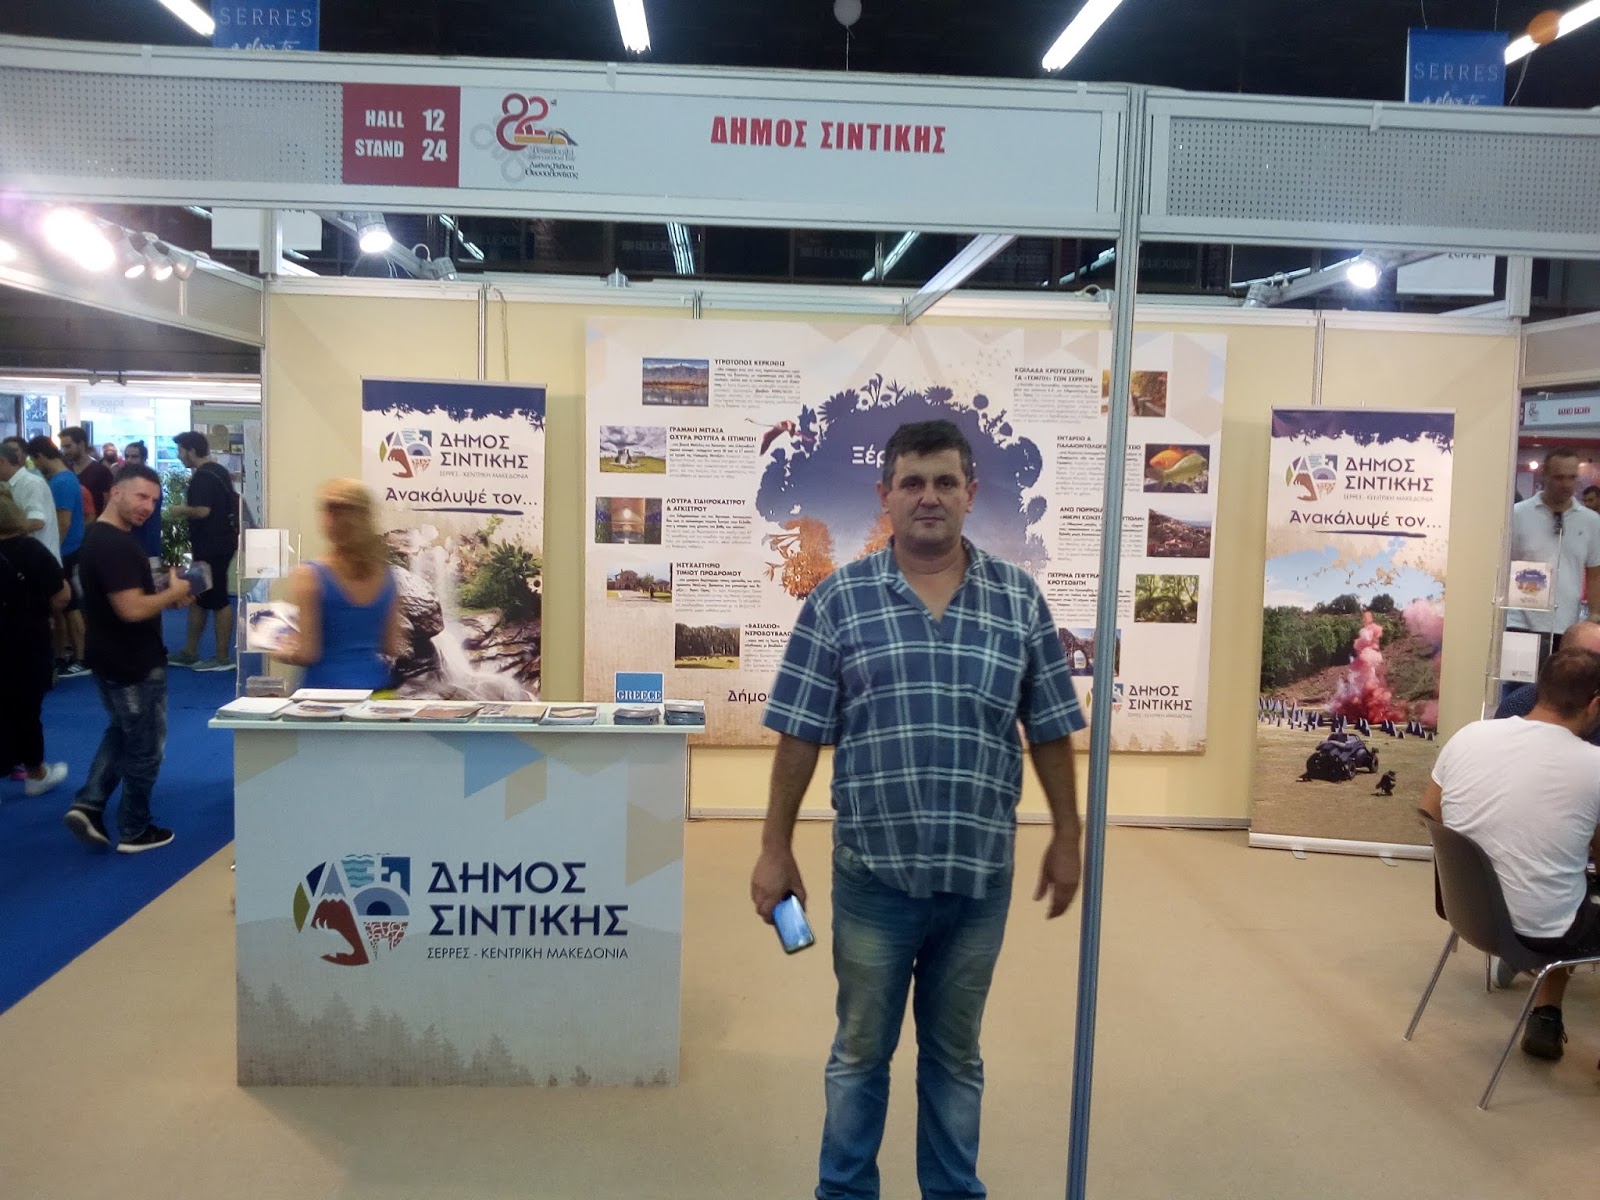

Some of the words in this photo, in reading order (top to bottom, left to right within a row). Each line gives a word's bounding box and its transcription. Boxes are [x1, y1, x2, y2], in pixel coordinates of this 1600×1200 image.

[219, 7, 313, 26] SERRES
[1414, 62, 1498, 81] SERRES
[365, 109, 405, 129] HALL
[422, 108, 446, 133] 12
[710, 115, 808, 149] ΔΗΜΟΣ
[820, 120, 947, 154] ΣΙΝΤΙΚΗΣ
[354, 138, 405, 159] STAND
[421, 138, 448, 163] 24
[440, 432, 510, 450] ΔΗΜΟΣ
[440, 451, 529, 469] ΣΙΝΤΙΚΗΣ
[851, 443, 886, 468] Ξέρ
[1345, 456, 1415, 472] ΔΗΜΟΣ
[1345, 475, 1434, 491] ΣΙΝΤΙΚΗΣ
[616, 690, 663, 701] GREECE
[1128, 684, 1180, 697] ΔΗΜΟΣ
[1128, 699, 1193, 711] ΣΙΝΤΙΚΗΣ
[427, 861, 587, 894] ΔΗΜΟΣ
[428, 904, 629, 937] ΣΙΝΤΙΚΗΣ
[427, 947, 470, 959] ΣΕΡΡΕΣ
[481, 947, 543, 959] ΚΕΝΤΡΙΚΗ
[546, 947, 629, 959] ΜΑΚΕΔΟΝΙΑ
